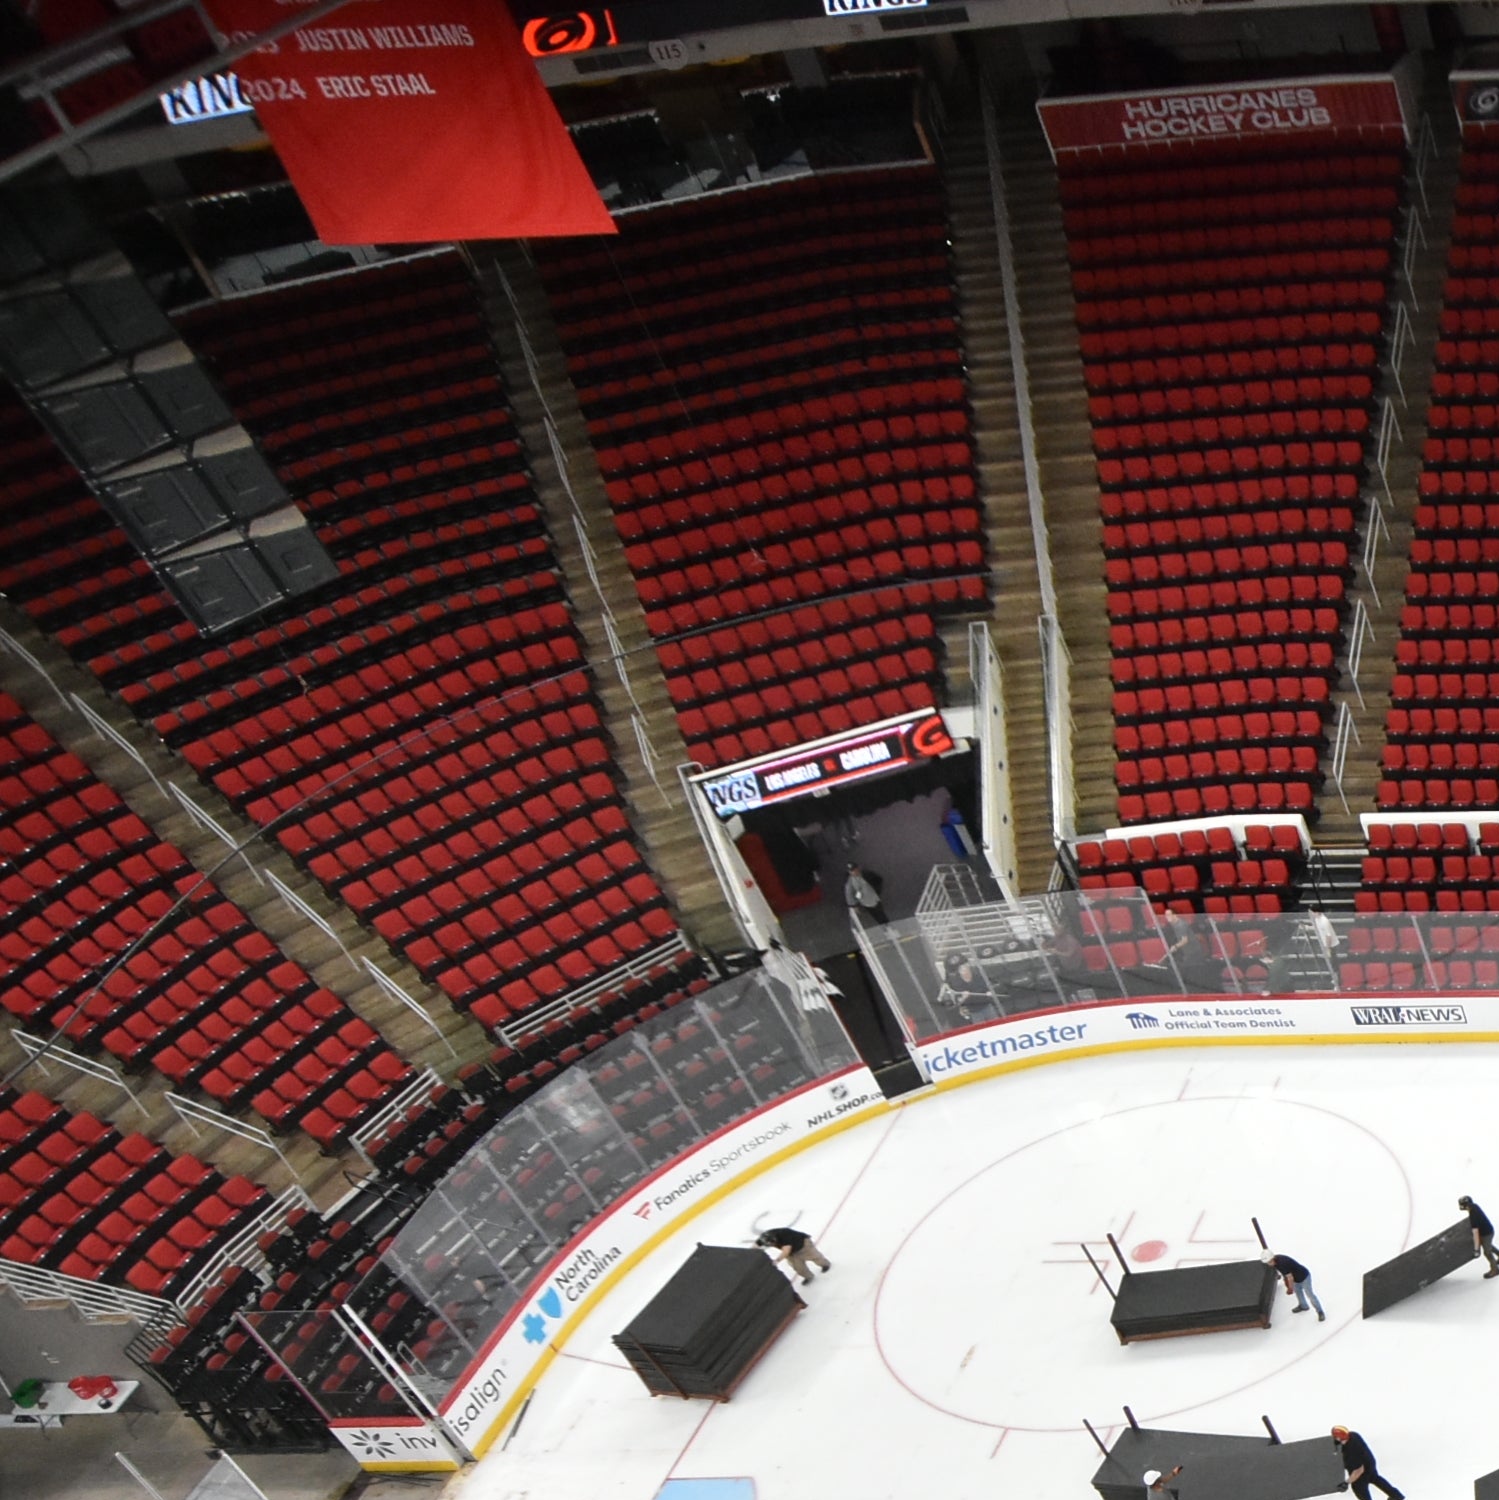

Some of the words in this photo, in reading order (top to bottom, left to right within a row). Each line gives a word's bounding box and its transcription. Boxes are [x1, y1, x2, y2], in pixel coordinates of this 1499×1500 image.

[296, 27, 368, 51] JUSTIN
[367, 25, 474, 49] WILLIAMS
[656, 46, 682, 61] 115
[244, 78, 307, 103] 2024
[318, 76, 371, 99] ERIC
[371, 74, 436, 96] STAAL
[1125, 88, 1317, 120] HURRICANES
[1122, 112, 1245, 140] HOCKEY
[1252, 107, 1330, 129] CLUB
[1165, 1020, 1212, 1030] Official
[1213, 1020, 1247, 1029] Team
[1249, 1019, 1296, 1028] Dentist
[1168, 1009, 1199, 1017] Lane
[1203, 1008, 1211, 1016] &
[1215, 1007, 1282, 1016] Associates
[1406, 1008, 1462, 1022] NEWS
[654, 1168, 711, 1211] Fanatics
[710, 1121, 792, 1172] Sportsbook
[554, 1248, 598, 1290] North
[566, 1246, 622, 1302] Carolina
